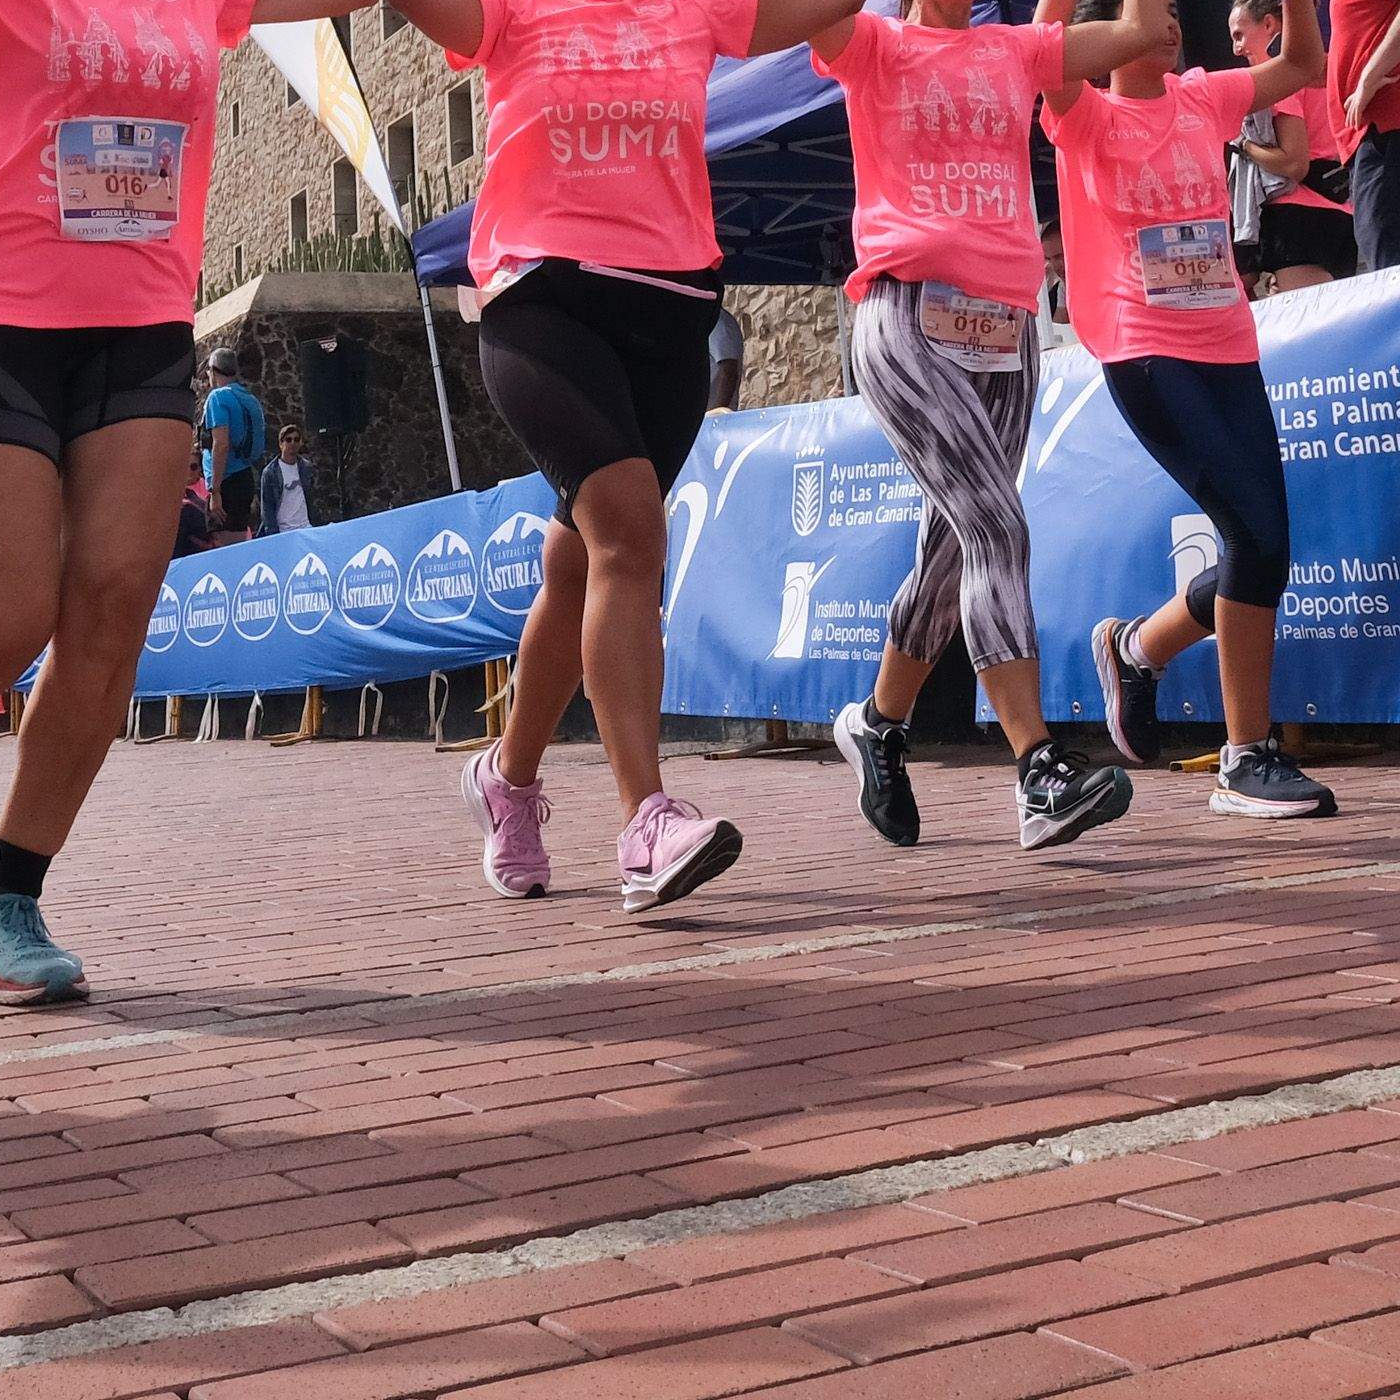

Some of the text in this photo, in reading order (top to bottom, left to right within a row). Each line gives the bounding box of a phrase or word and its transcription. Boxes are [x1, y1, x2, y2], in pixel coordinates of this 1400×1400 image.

[541, 100, 691, 124] TU DORSAL
[549, 124, 680, 164] SUMA
[906, 162, 1017, 182] TU DORSAL
[105, 174, 143, 196] 016
[91, 209, 122, 218] CARRERA
[1175, 260, 1208, 276] 016
[955, 316, 992, 334] 016
[1280, 407, 1318, 431] Las
[830, 480, 923, 504] de Las Palmas
[828, 502, 921, 527] de Gran Canaria
[424, 559, 470, 574] CENTRAL LECHERA
[494, 548, 520, 561] CENTRAL
[411, 568, 474, 602] ASTURIANA
[487, 556, 543, 593] ASTURIA
[1287, 560, 1336, 586] ituto
[287, 586, 330, 615] ASTURIANA
[341, 577, 394, 610] ASTURIANA
[186, 602, 225, 630] ASTURIANA
[235, 594, 277, 622] ASTURIANA
[814, 600, 890, 618] Instituto Muni
[1283, 591, 1390, 621] Deportes
[811, 623, 880, 646] de Deportes
[1282, 624, 1336, 640] Palmas
[1340, 623, 1359, 639] de
[808, 647, 821, 659] Las
[823, 648, 849, 660] Palmas
[851, 649, 861, 660] de
